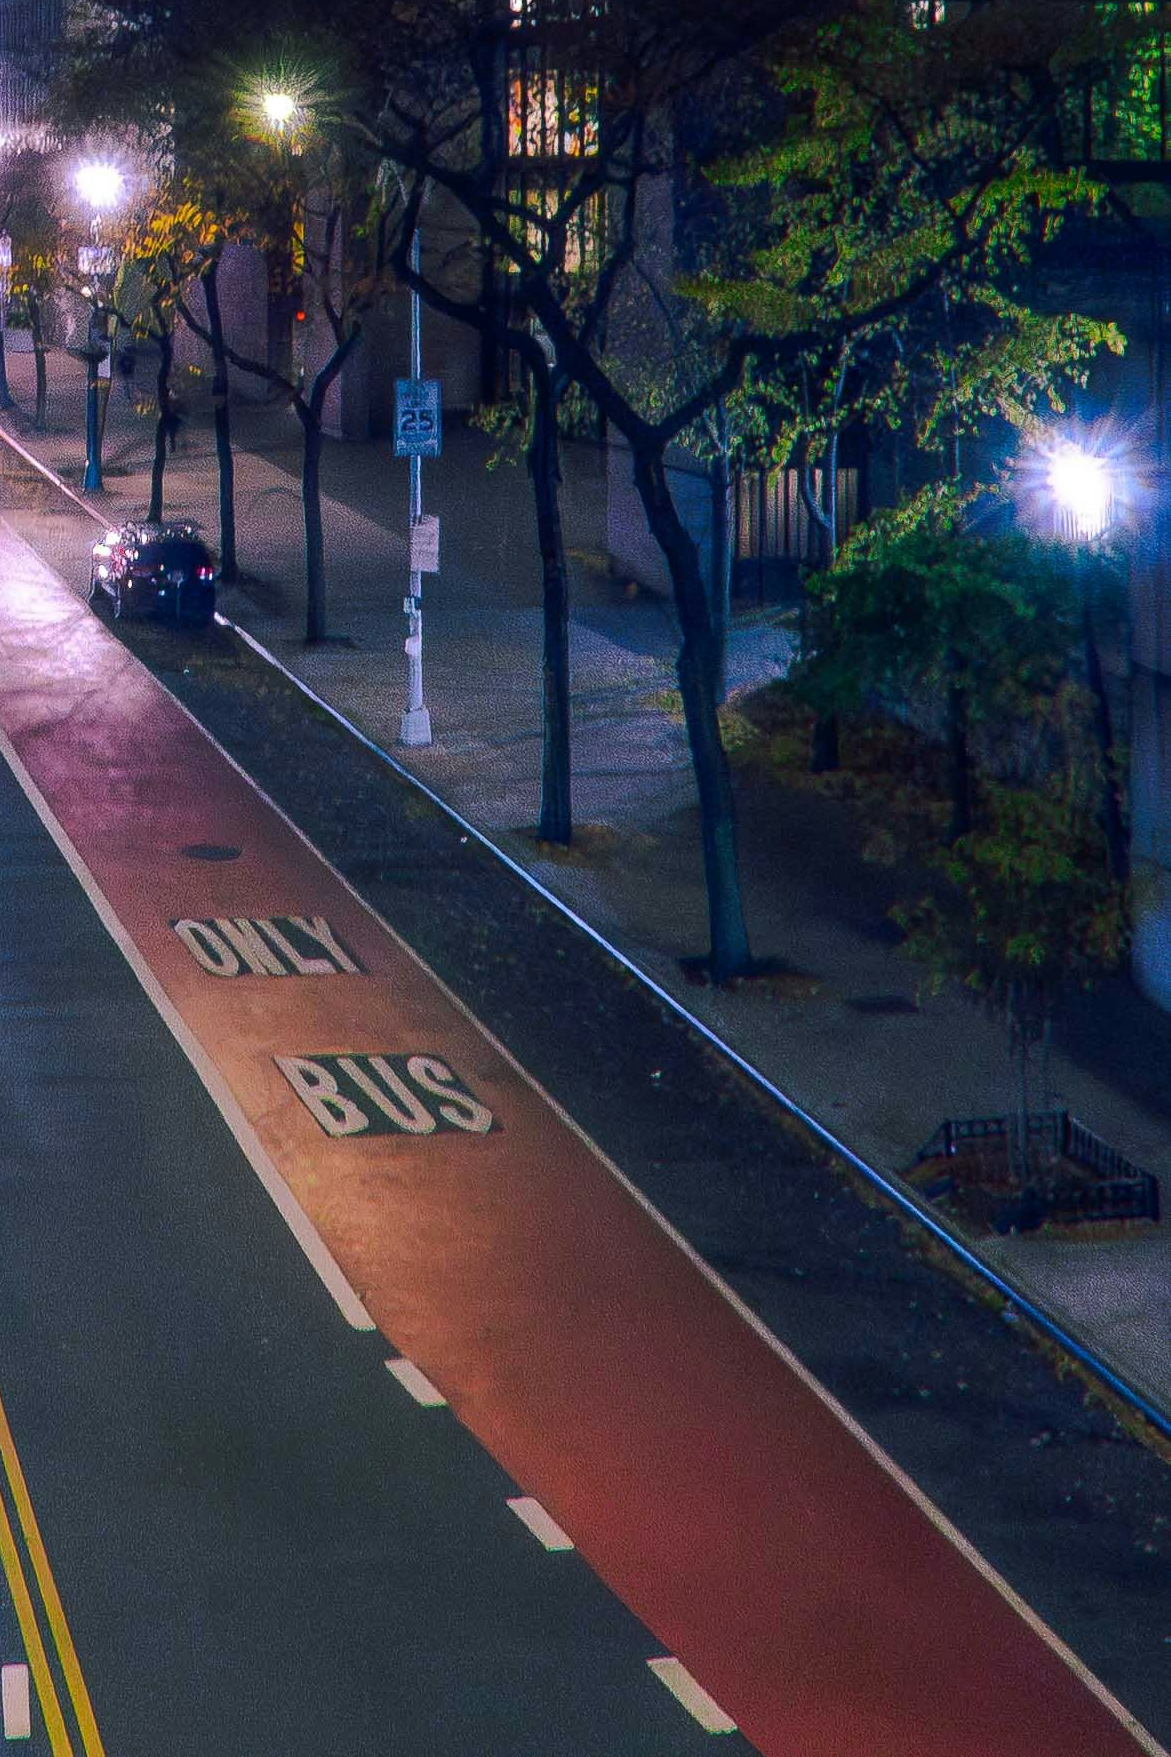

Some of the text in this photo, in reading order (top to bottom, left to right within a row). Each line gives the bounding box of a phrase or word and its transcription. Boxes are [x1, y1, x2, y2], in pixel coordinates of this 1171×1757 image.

[400, 409, 434, 432] 25
[174, 916, 361, 977] ONLY
[274, 1056, 493, 1137] BUS
